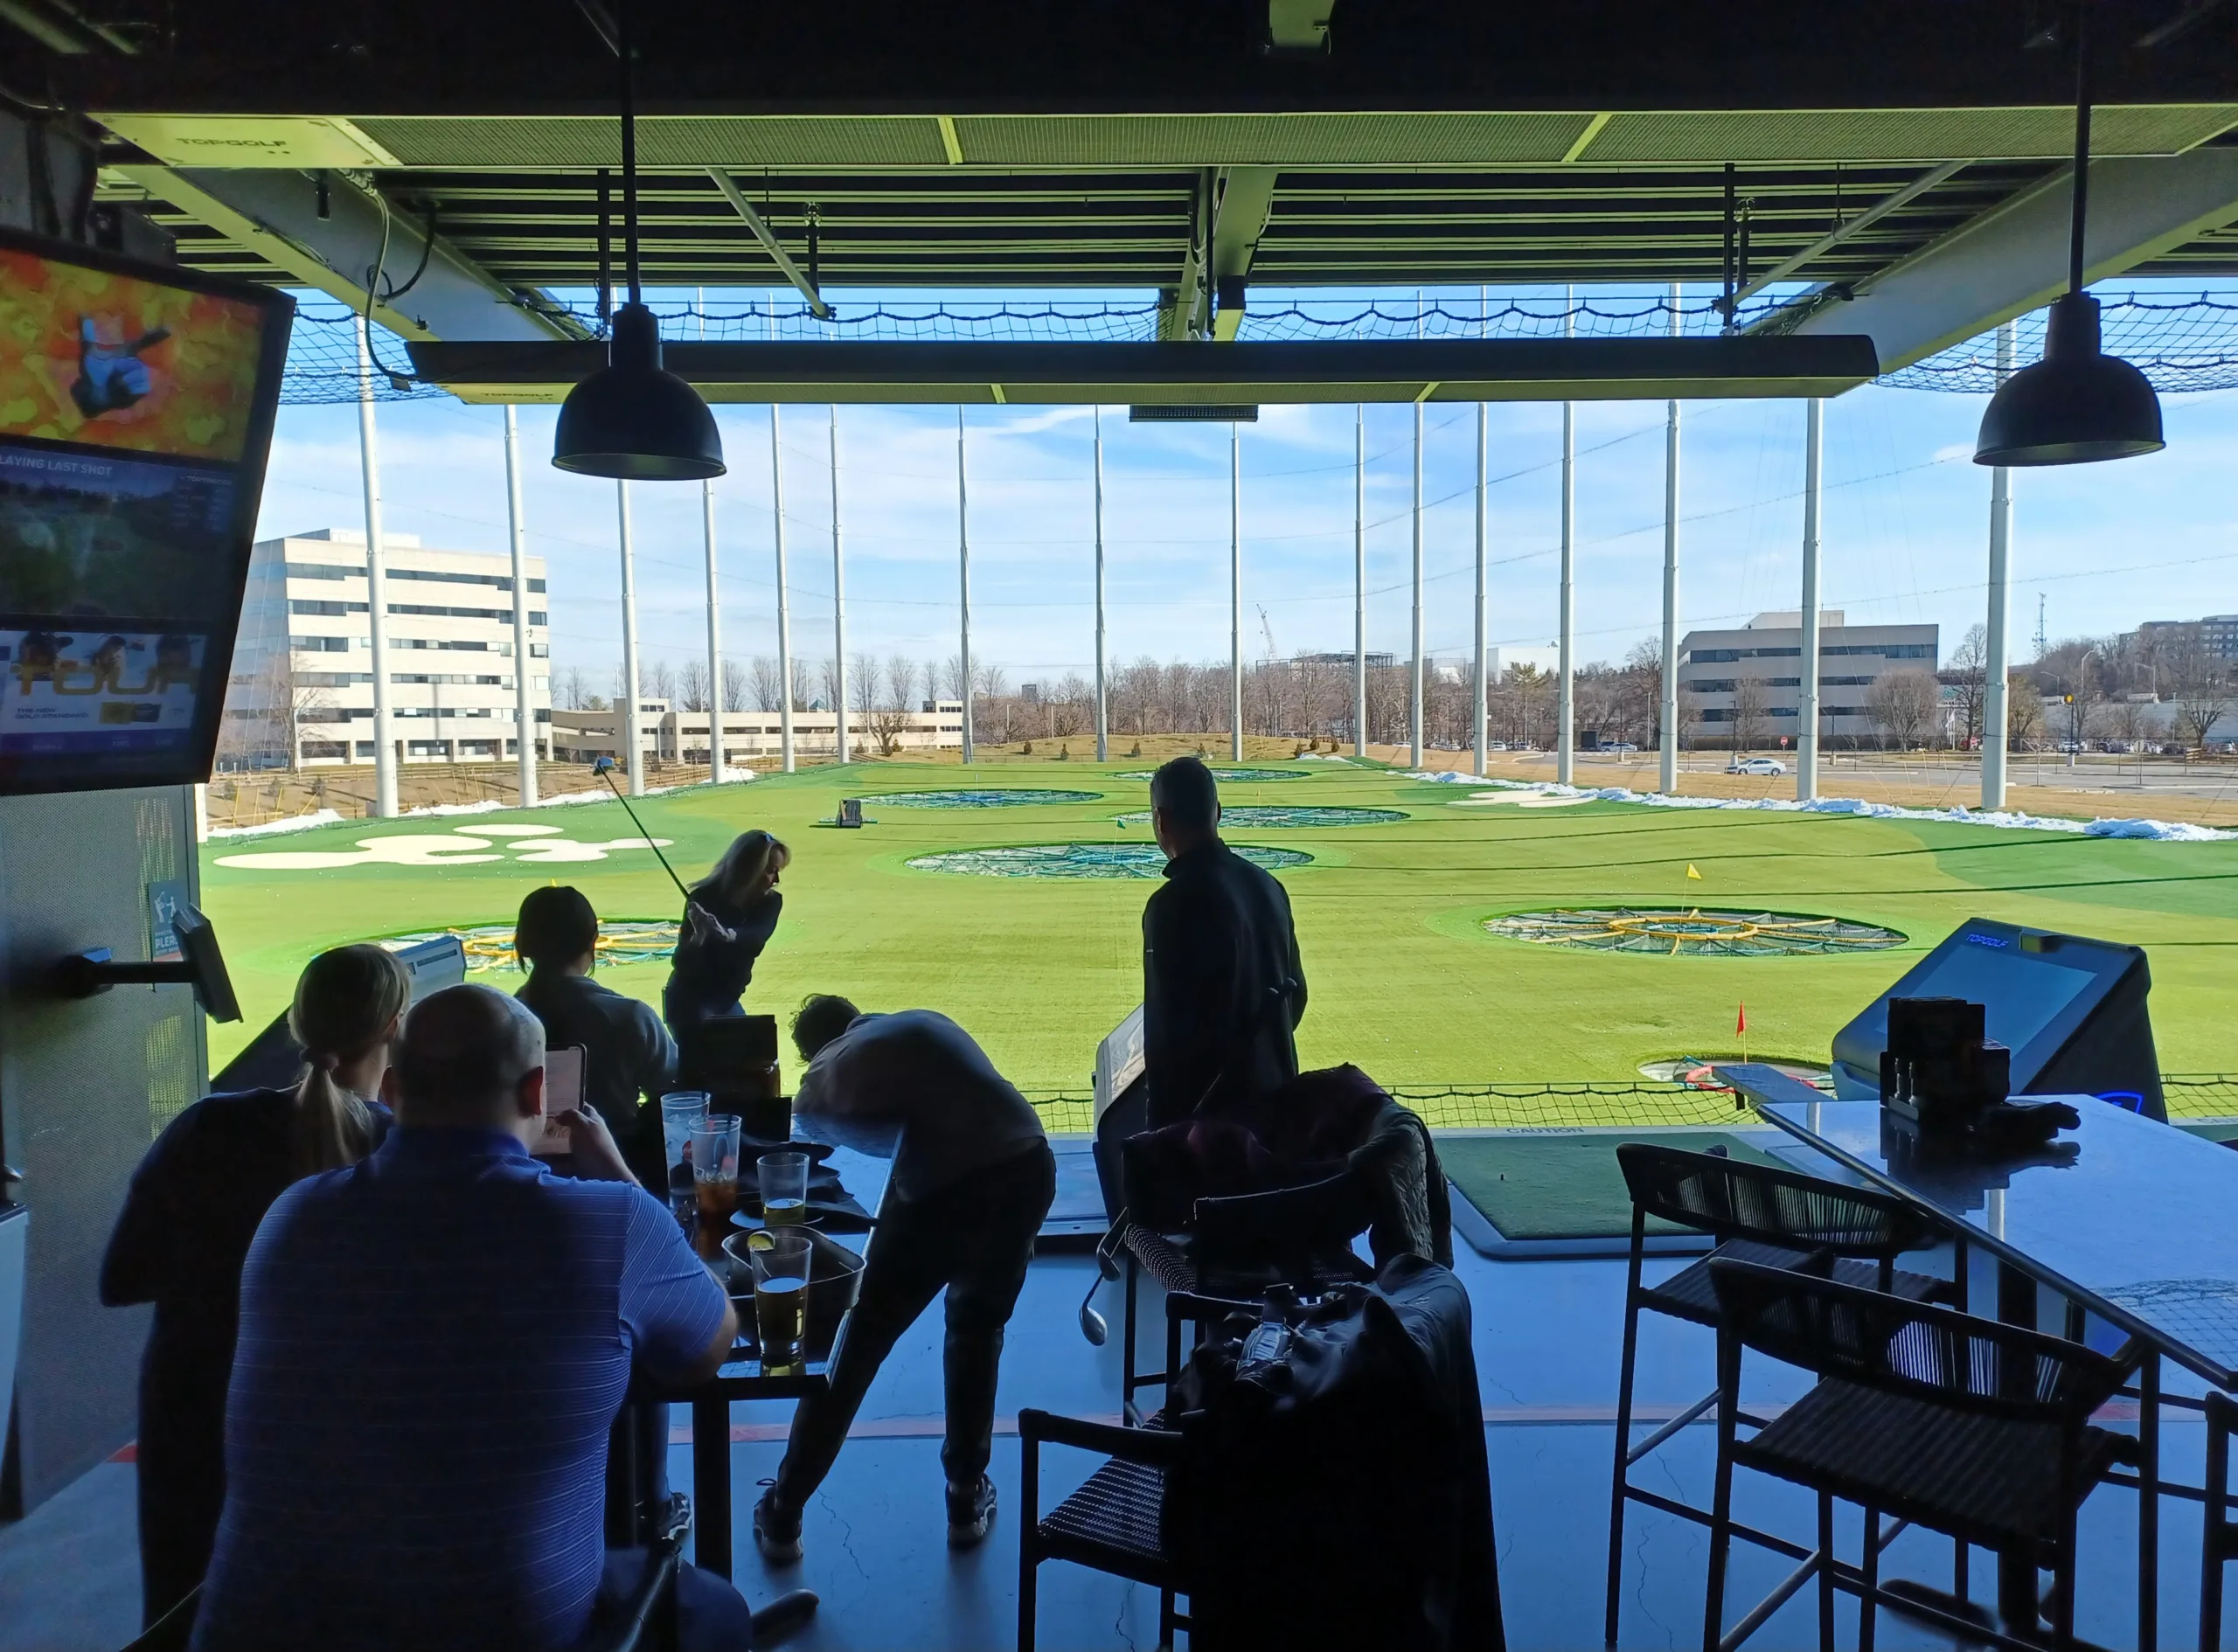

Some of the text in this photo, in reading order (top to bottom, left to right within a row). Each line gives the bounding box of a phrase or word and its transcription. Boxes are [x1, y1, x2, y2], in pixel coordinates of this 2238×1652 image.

[177, 137, 287, 147] TOPGOLF
[0, 454, 112, 476] LAYING LAST SHOT
[10, 663, 201, 696] TOUR
[155, 935, 177, 948] PLEA
[1966, 934, 2009, 947] TOPGOLF
